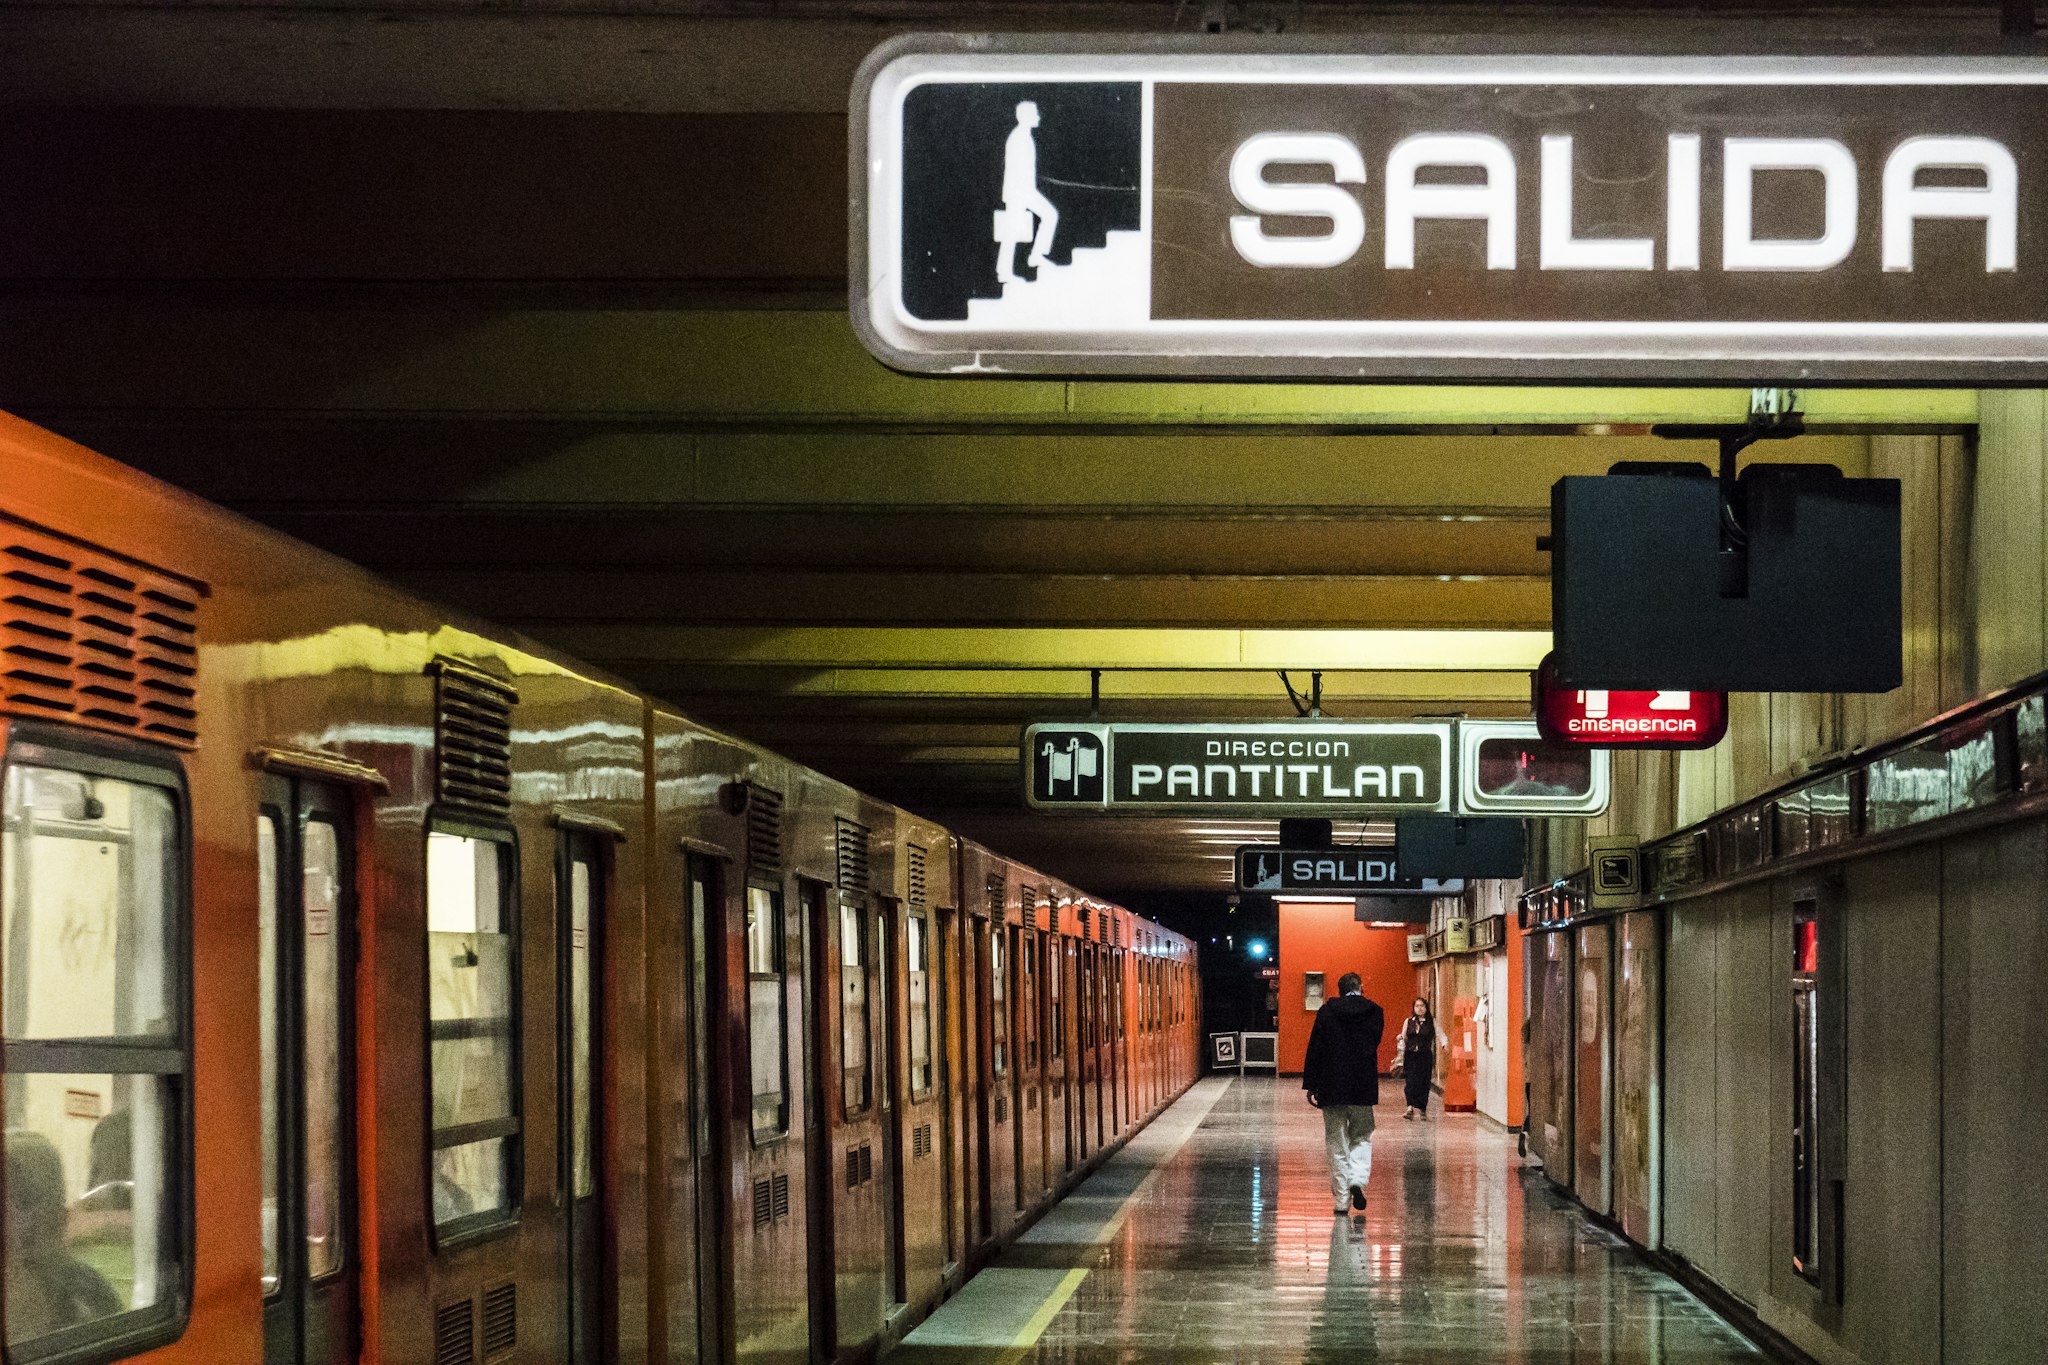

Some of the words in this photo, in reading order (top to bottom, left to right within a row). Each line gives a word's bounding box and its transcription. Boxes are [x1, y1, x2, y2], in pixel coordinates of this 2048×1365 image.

[1229, 132, 2018, 273] SALIDA
[1568, 718, 1697, 732] EMERGENCIA
[1206, 740, 1350, 757] DIRECCION
[1132, 764, 1424, 798] PANTITLAN
